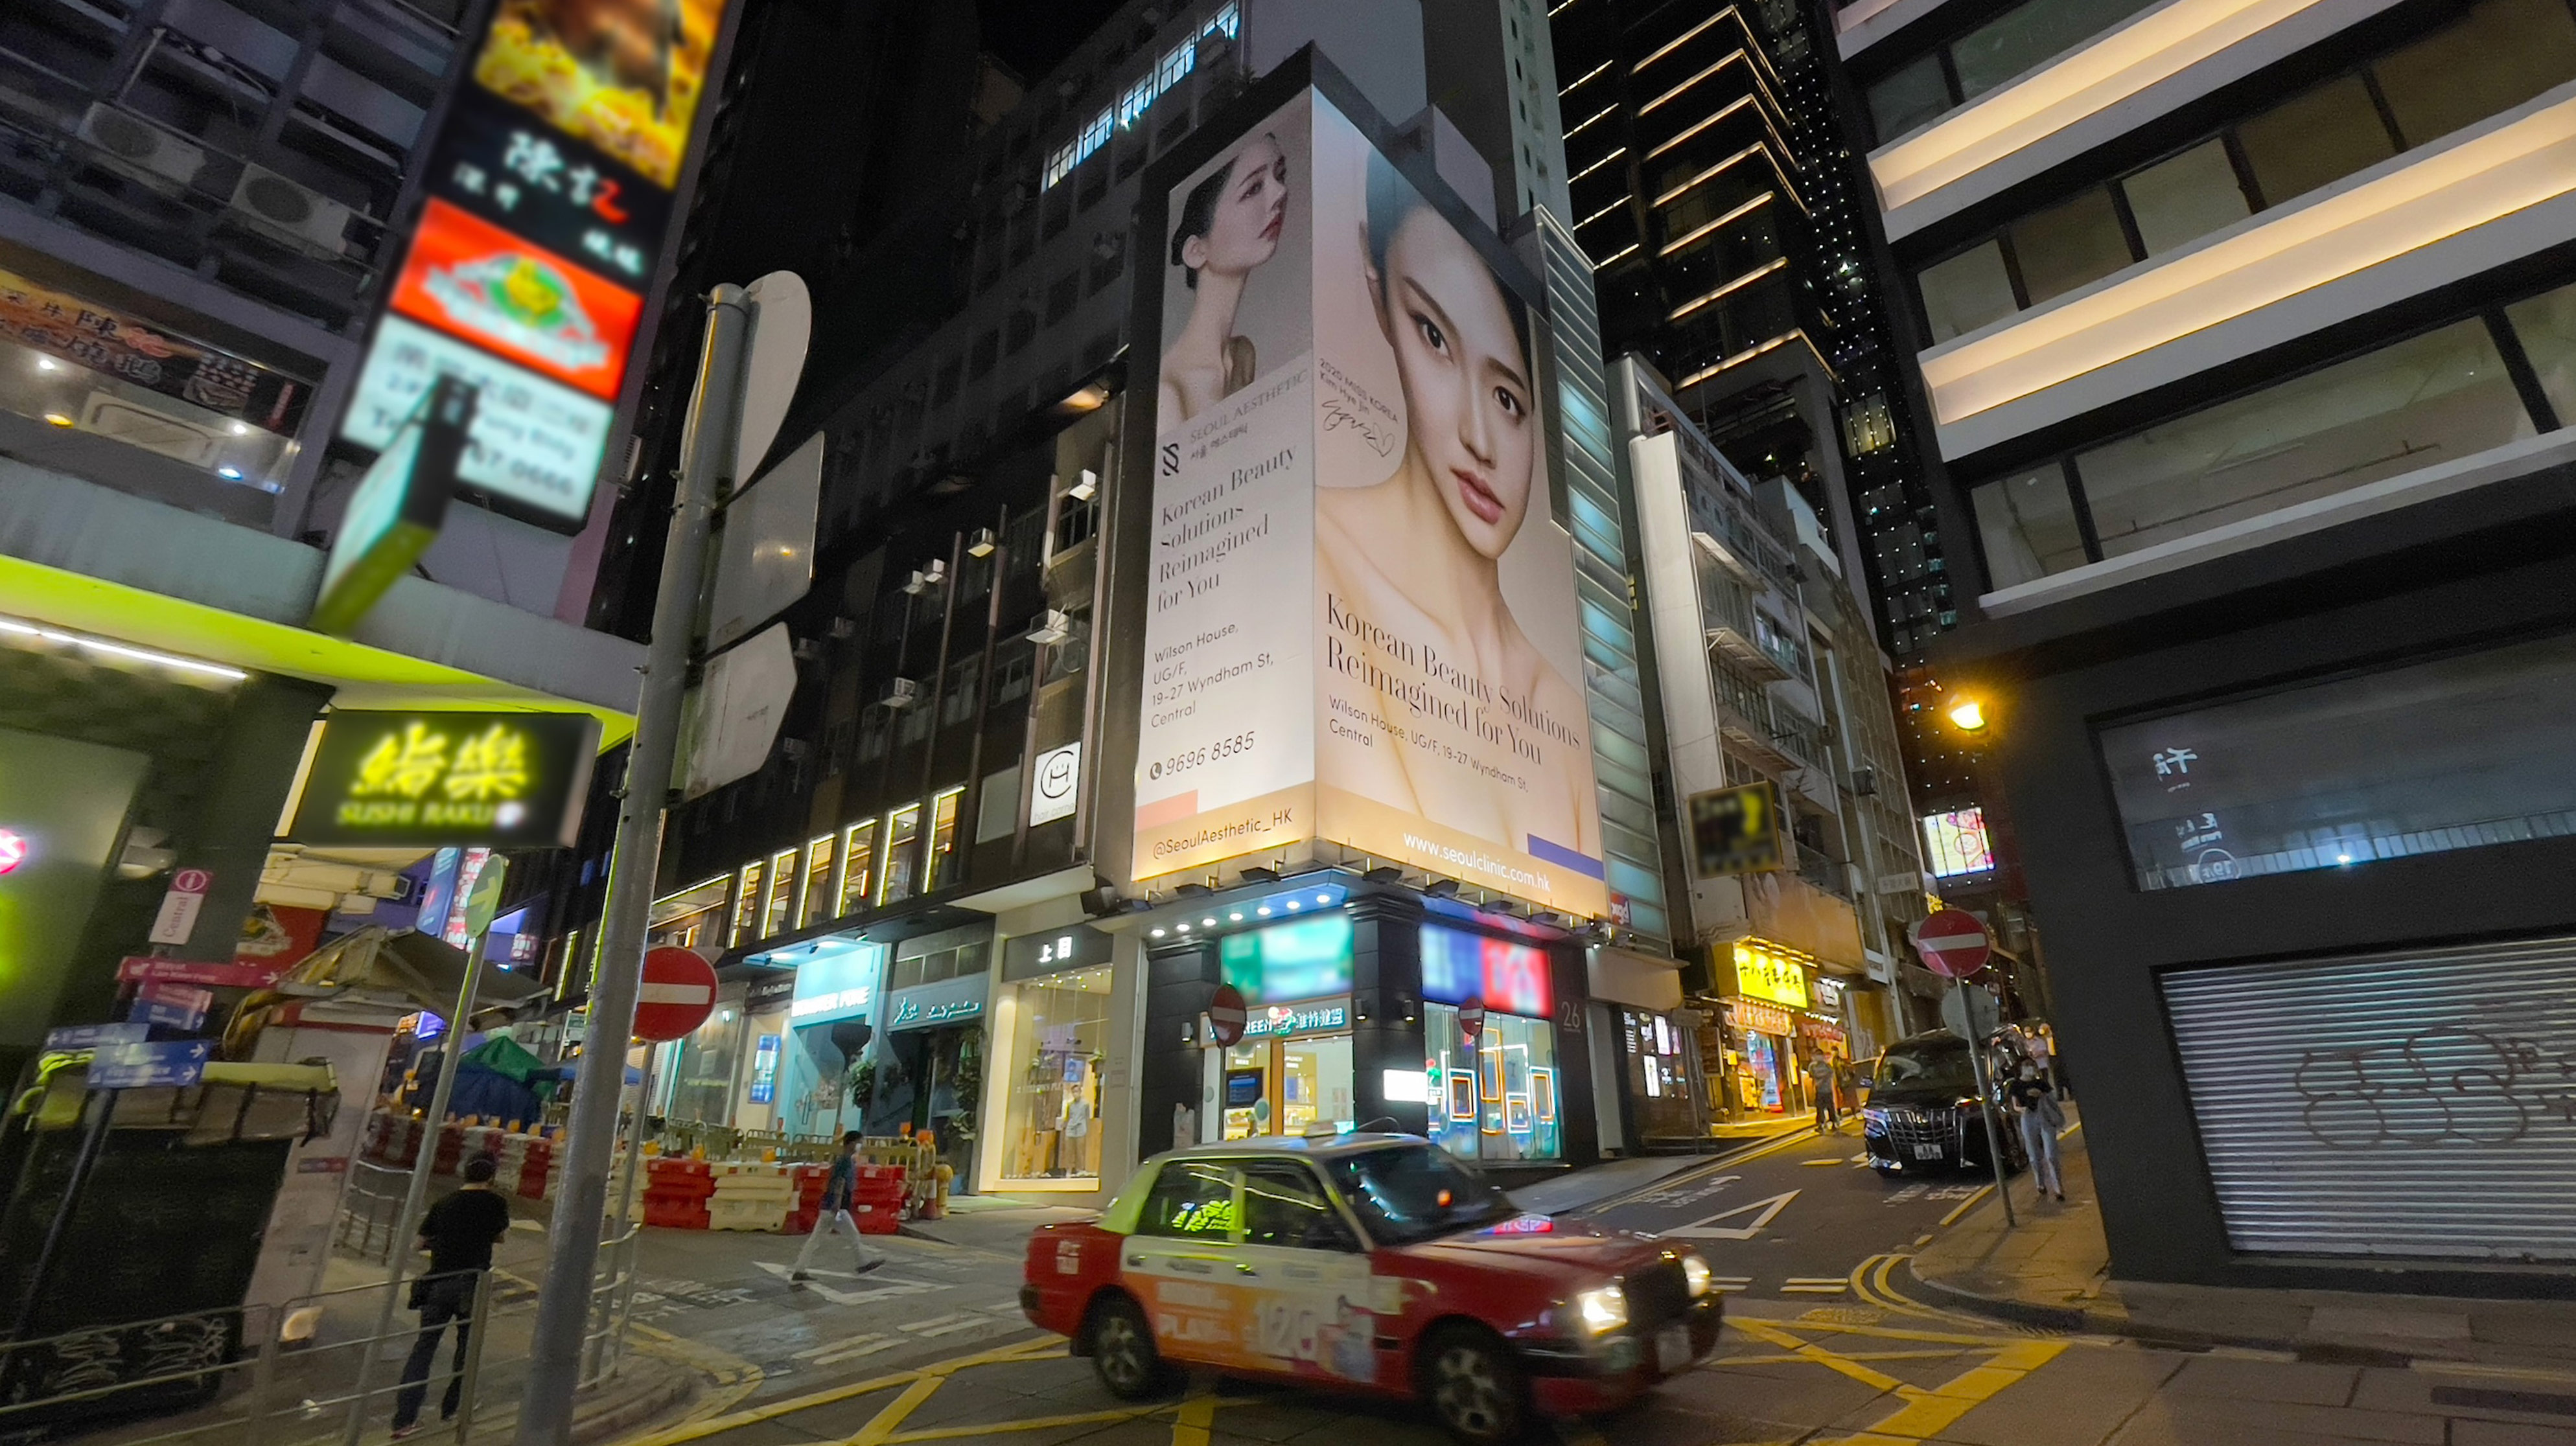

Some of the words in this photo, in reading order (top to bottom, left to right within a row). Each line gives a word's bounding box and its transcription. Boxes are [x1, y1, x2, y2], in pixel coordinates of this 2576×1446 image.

[1190, 414, 1230, 443] SEOUL
[1233, 369, 1308, 420] AESTHETIC
[1369, 396, 1398, 424] KOREA
[1162, 483, 1224, 526] Korean
[1231, 446, 1296, 490] Beauty
[1160, 513, 1268, 583] Reimagined
[1161, 505, 1244, 549] Solutions
[1158, 589, 1183, 613] for
[1188, 573, 1220, 598] You
[1154, 641, 1193, 663] Wilson
[1196, 623, 1239, 647] House,
[1152, 683, 1184, 706] 19-27
[1187, 660, 1253, 693] Wyndham
[1153, 661, 1187, 685] UG/F,
[1327, 590, 1414, 666] Korean
[1423, 644, 1492, 713] Beauty
[1499, 685, 1581, 751] Solutions
[1151, 700, 1196, 728] Central
[1327, 634, 1468, 731] Reimagined
[1476, 706, 1503, 745] for
[1507, 723, 1542, 766] You
[1166, 747, 1206, 776] 9696
[1211, 731, 1255, 761] 8585
[1329, 718, 1373, 748] Central
[1329, 694, 1368, 723] Wilson
[1443, 745, 1468, 765] 19-27
[1470, 756, 1516, 786] Wyndham
[1153, 808, 1293, 860] @SeoulAesthetic_HK
[1404, 832, 1551, 893] www.seoulclinic.com.hk
[162, 897, 189, 937] Central
[1561, 1001, 1581, 1028] 26
